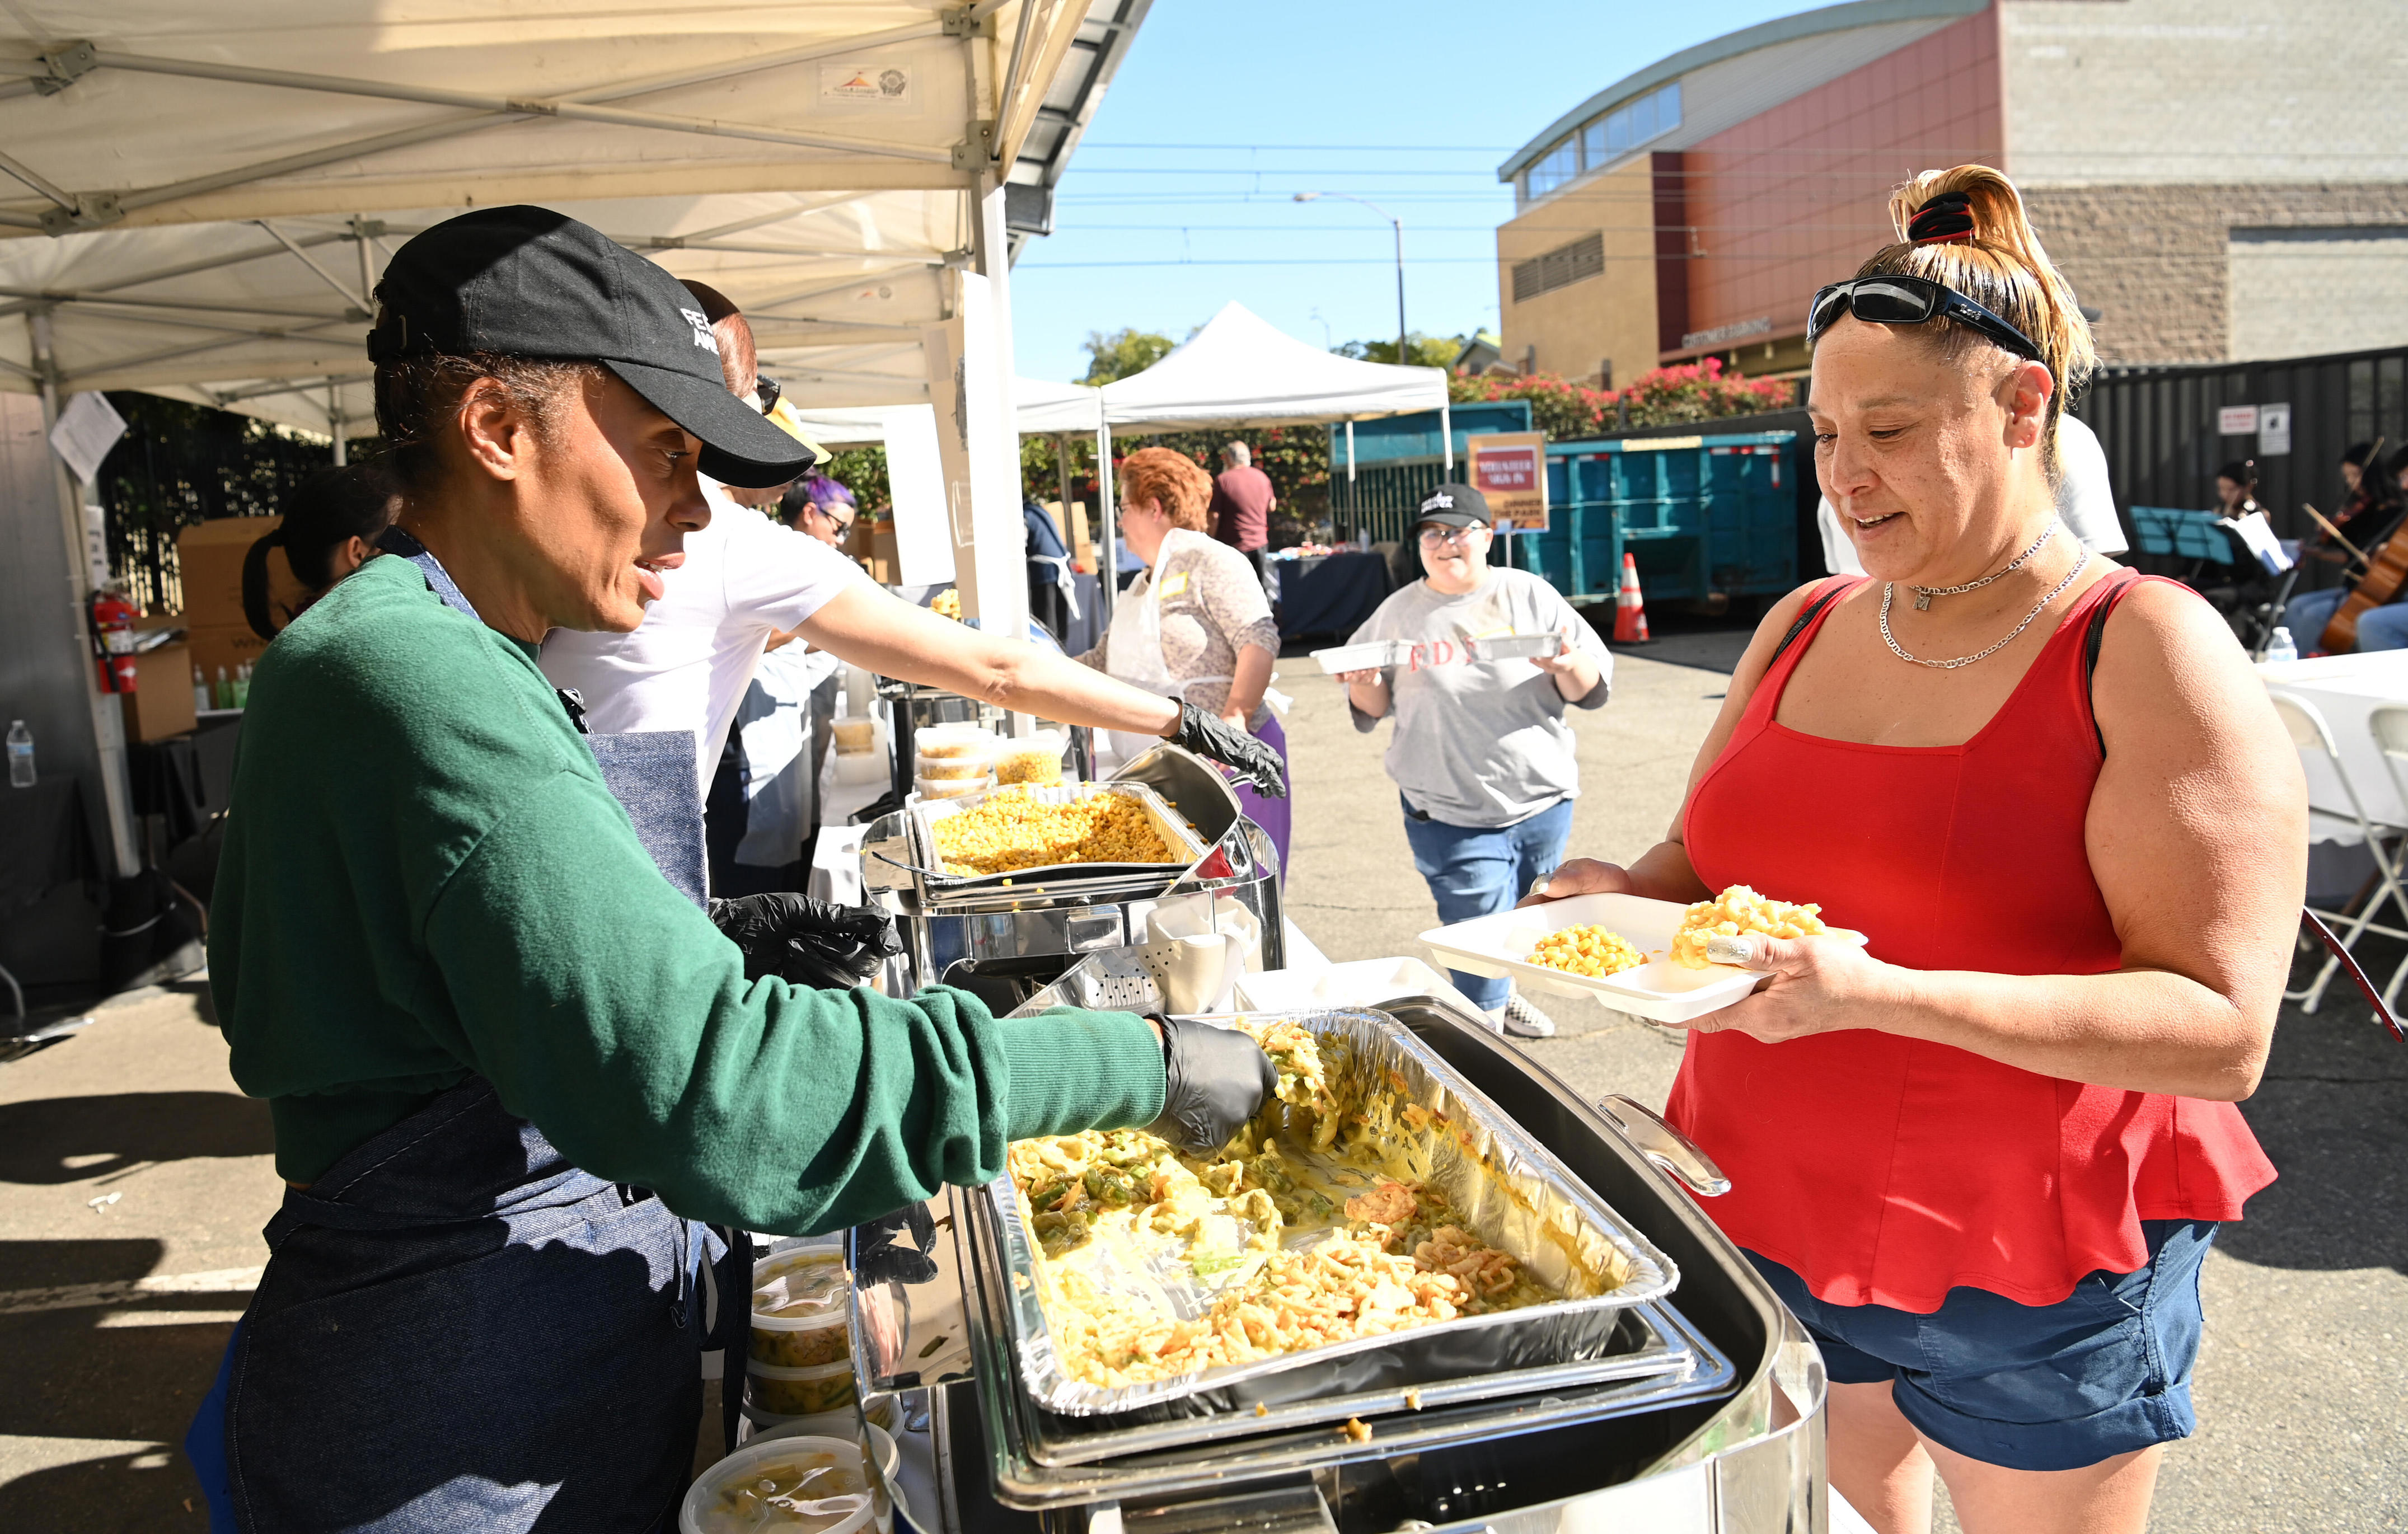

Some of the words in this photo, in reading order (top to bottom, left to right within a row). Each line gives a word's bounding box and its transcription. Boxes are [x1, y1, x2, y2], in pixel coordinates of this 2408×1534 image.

[1478, 459, 1533, 473] VOLUNTEER
[1487, 473, 1511, 485] SIGN
[1513, 472, 1525, 484] IN
